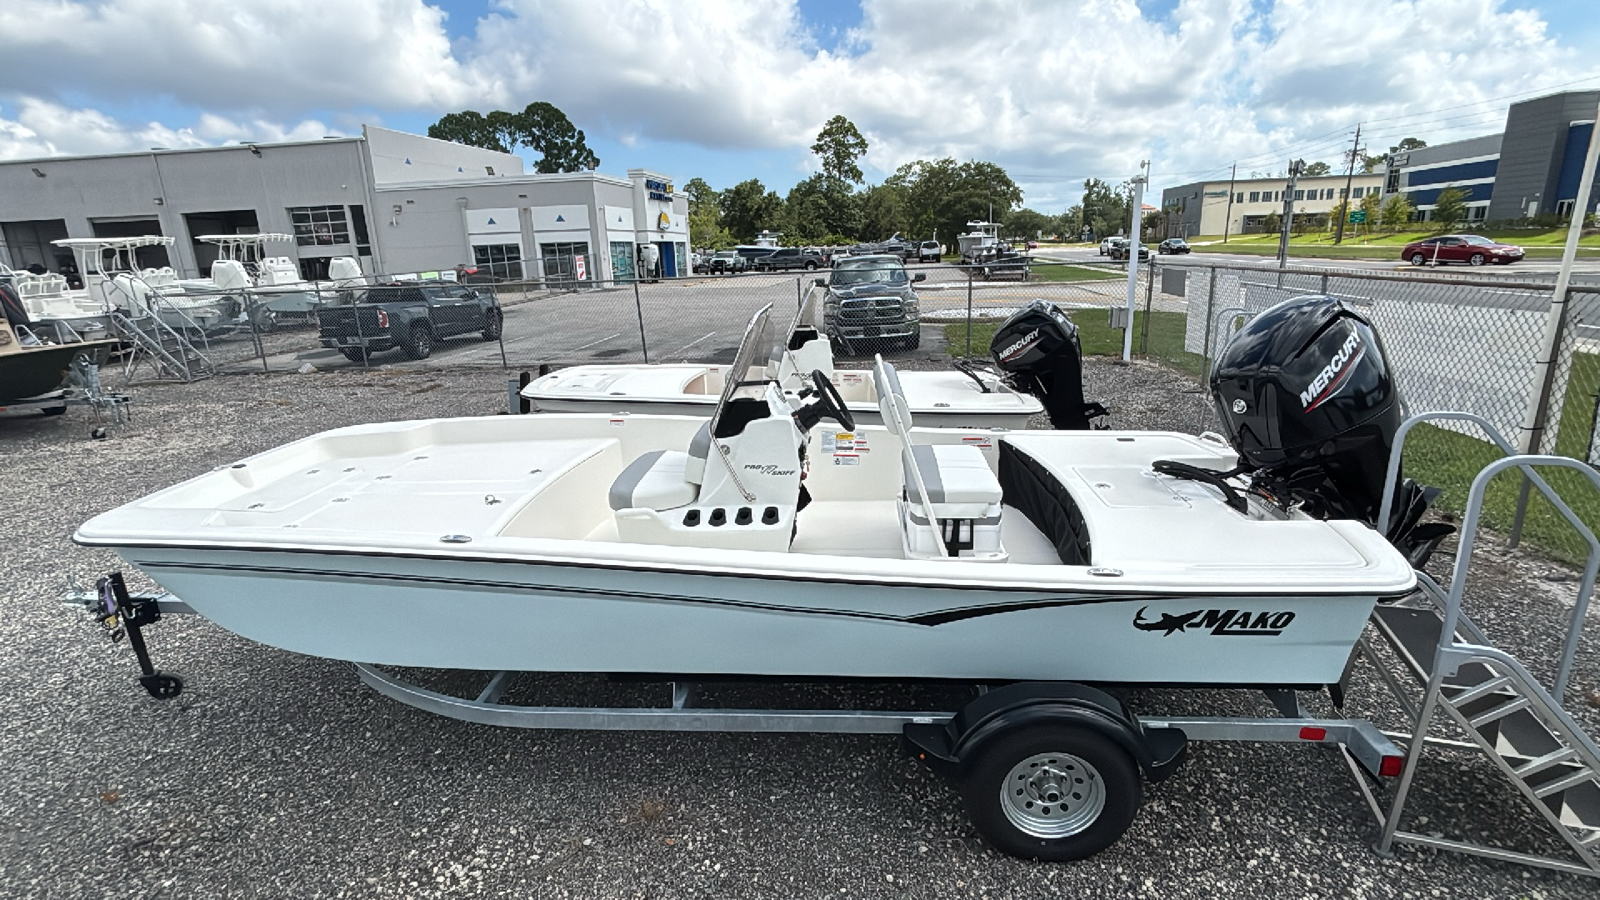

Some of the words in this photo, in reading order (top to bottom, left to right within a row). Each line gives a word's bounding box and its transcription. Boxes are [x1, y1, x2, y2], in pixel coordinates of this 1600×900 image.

[999, 327, 1039, 360] MERCURY
[1300, 325, 1360, 408] MERCURY
[1186, 609, 1296, 636] MAKO
